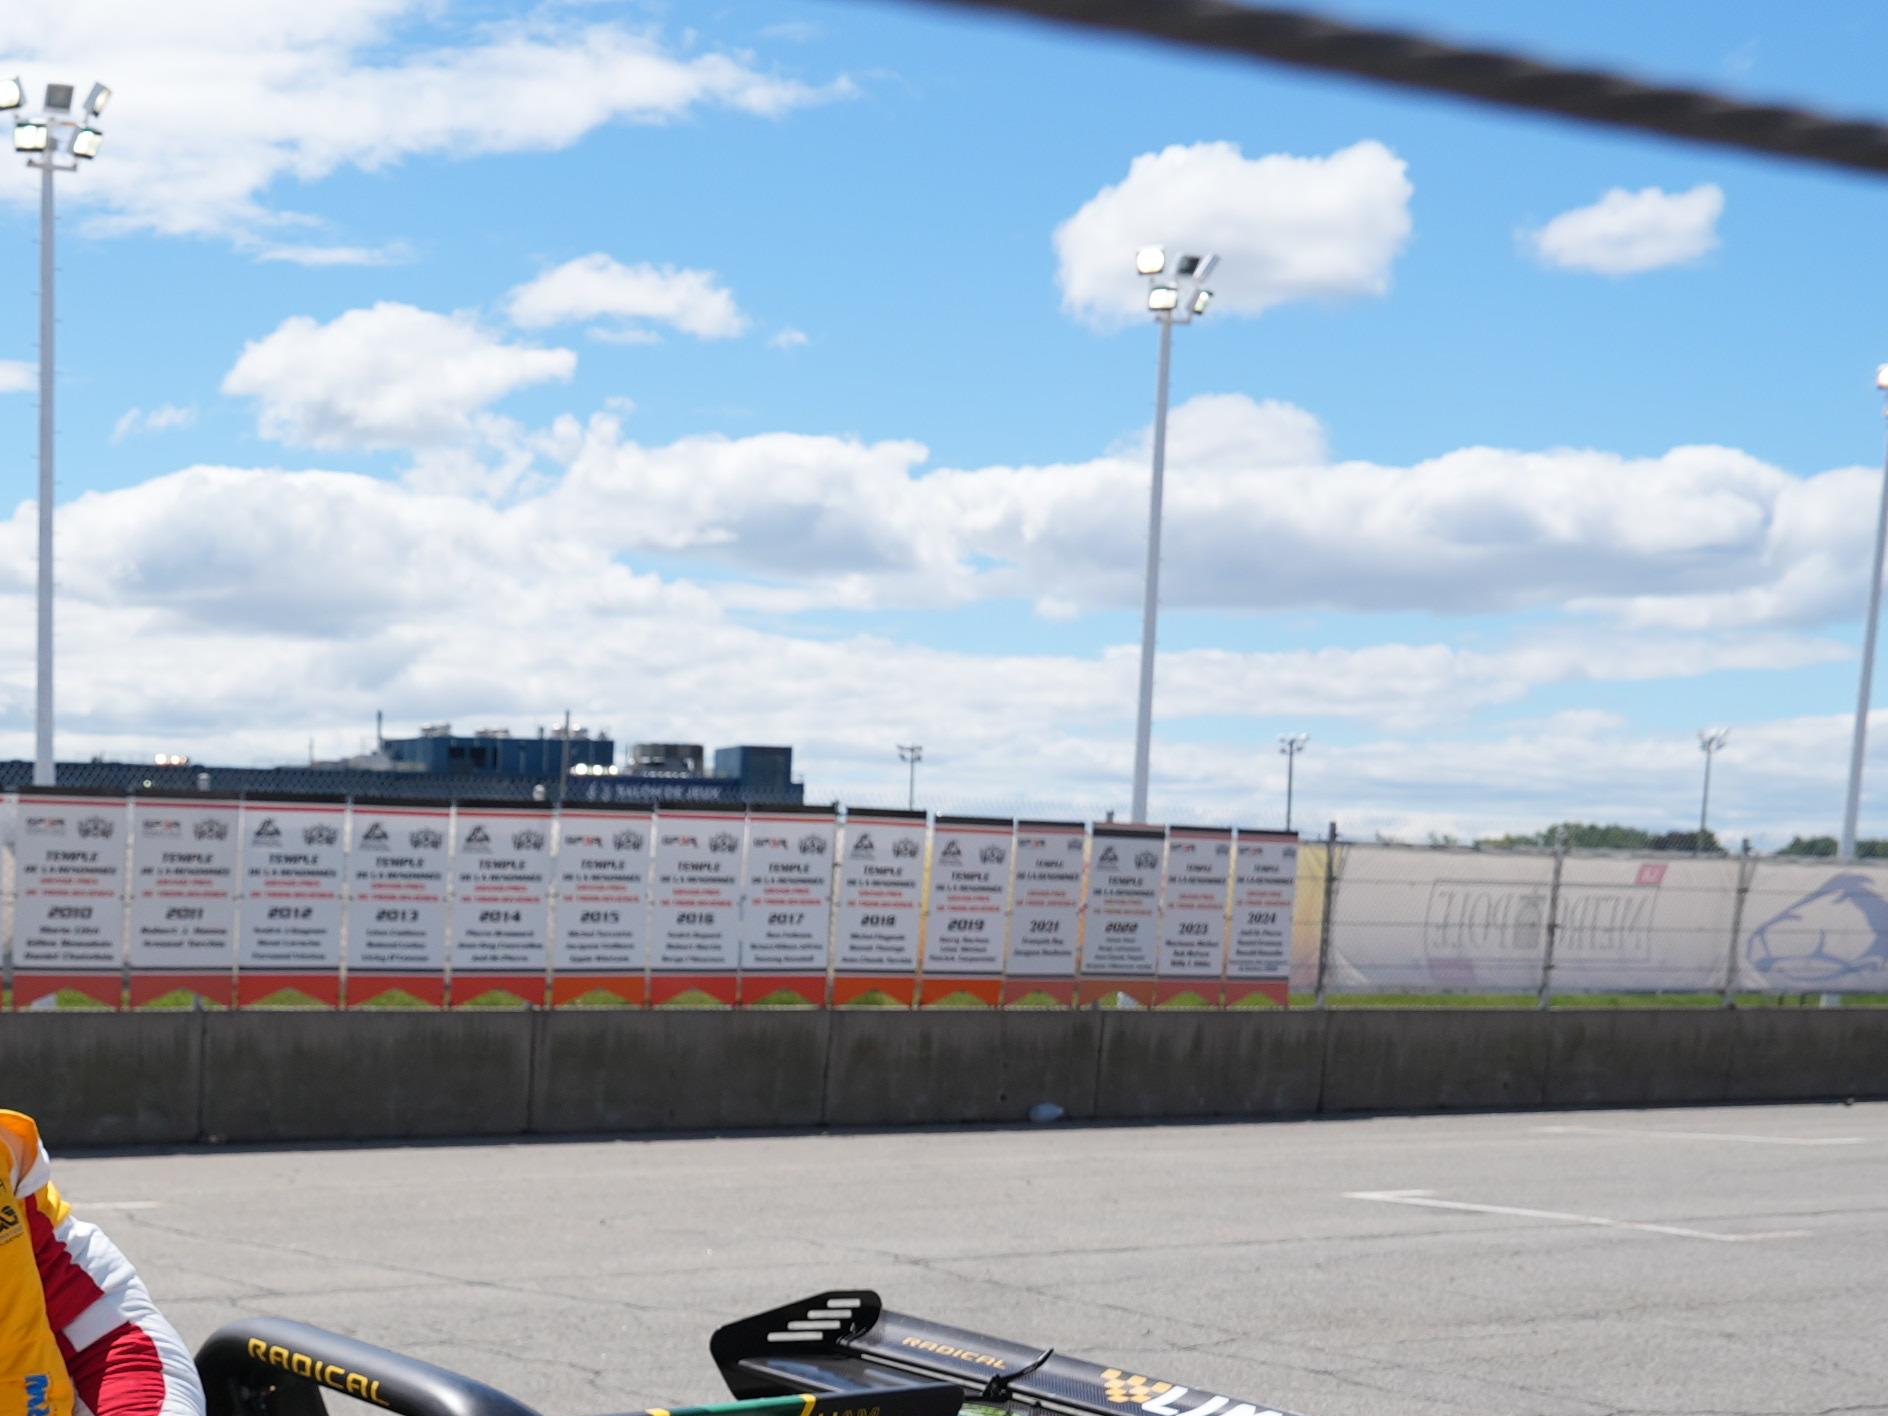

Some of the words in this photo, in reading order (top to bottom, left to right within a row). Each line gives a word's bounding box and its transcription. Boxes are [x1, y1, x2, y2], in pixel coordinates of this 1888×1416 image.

[166, 907, 204, 920] 2011
[267, 907, 313, 920] 2012
[479, 910, 521, 922] 2014
[580, 912, 620, 923] 2015
[768, 913, 803, 925] 2017
[1247, 912, 1277, 925] 2024
[947, 919, 985, 931] 2019
[1179, 923, 1208, 935] 2023
[902, 1336, 1008, 1370] RADICAL
[248, 1337, 390, 1407] RADICAL
